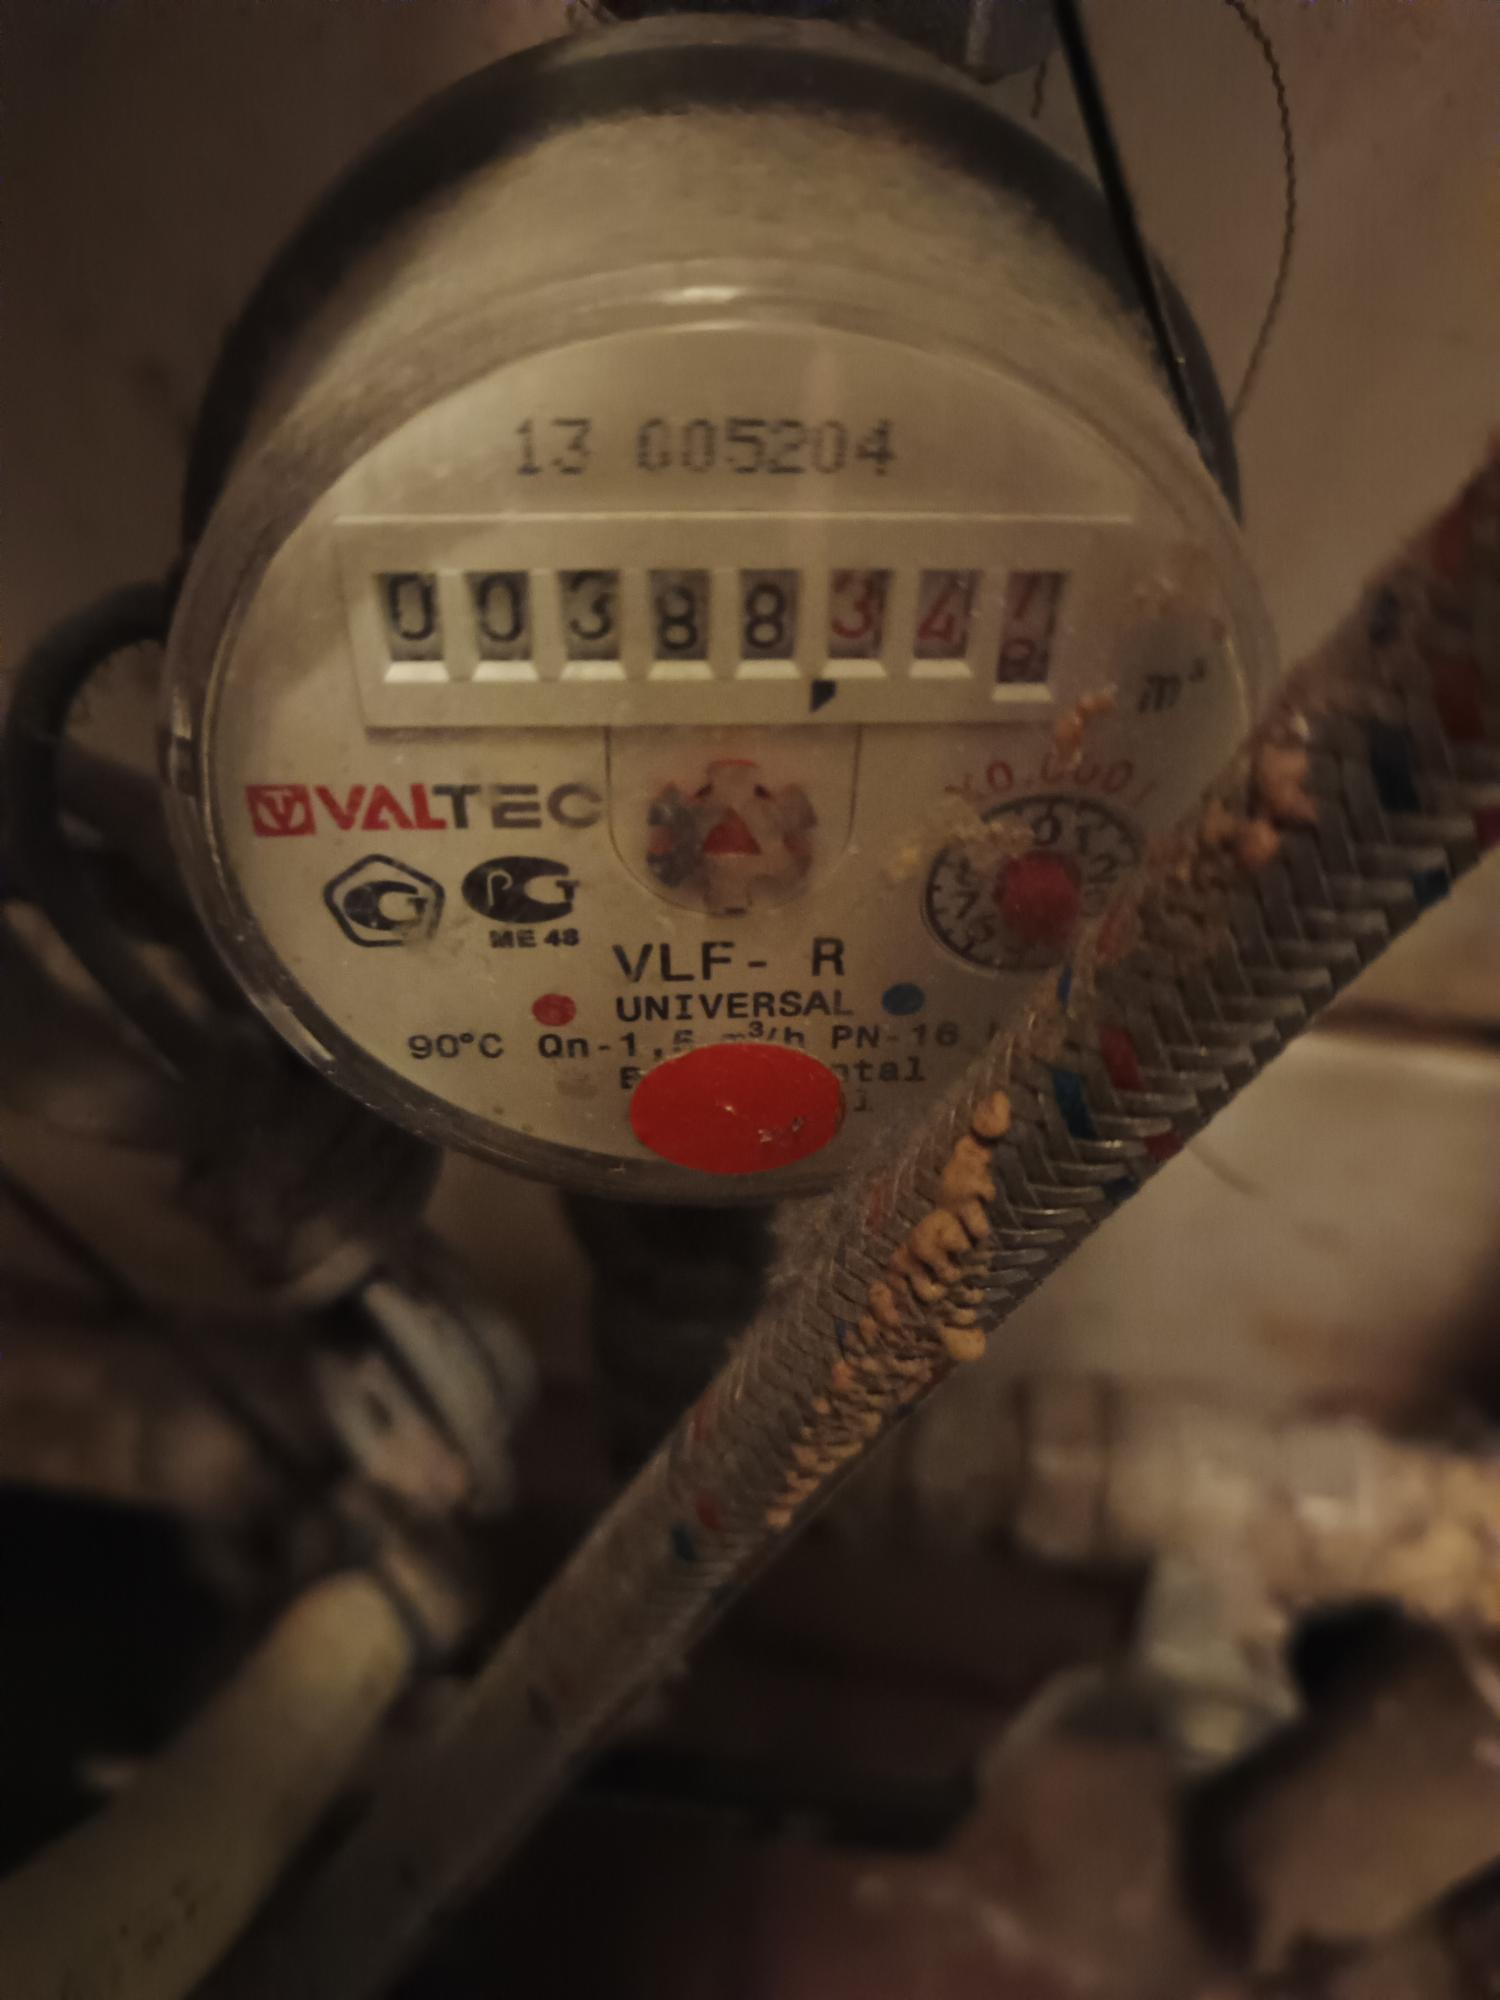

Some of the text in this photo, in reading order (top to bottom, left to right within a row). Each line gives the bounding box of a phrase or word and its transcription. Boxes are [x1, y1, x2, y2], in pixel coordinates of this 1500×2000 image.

[515, 416, 896, 476] 13 005204
[315, 782, 603, 830] VALTEC
[544, 929, 579, 947] 48
[616, 990, 854, 1022] UNIVERSAL
[408, 1033, 504, 1060] 90°C
[831, 1022, 959, 1050] PN-16
